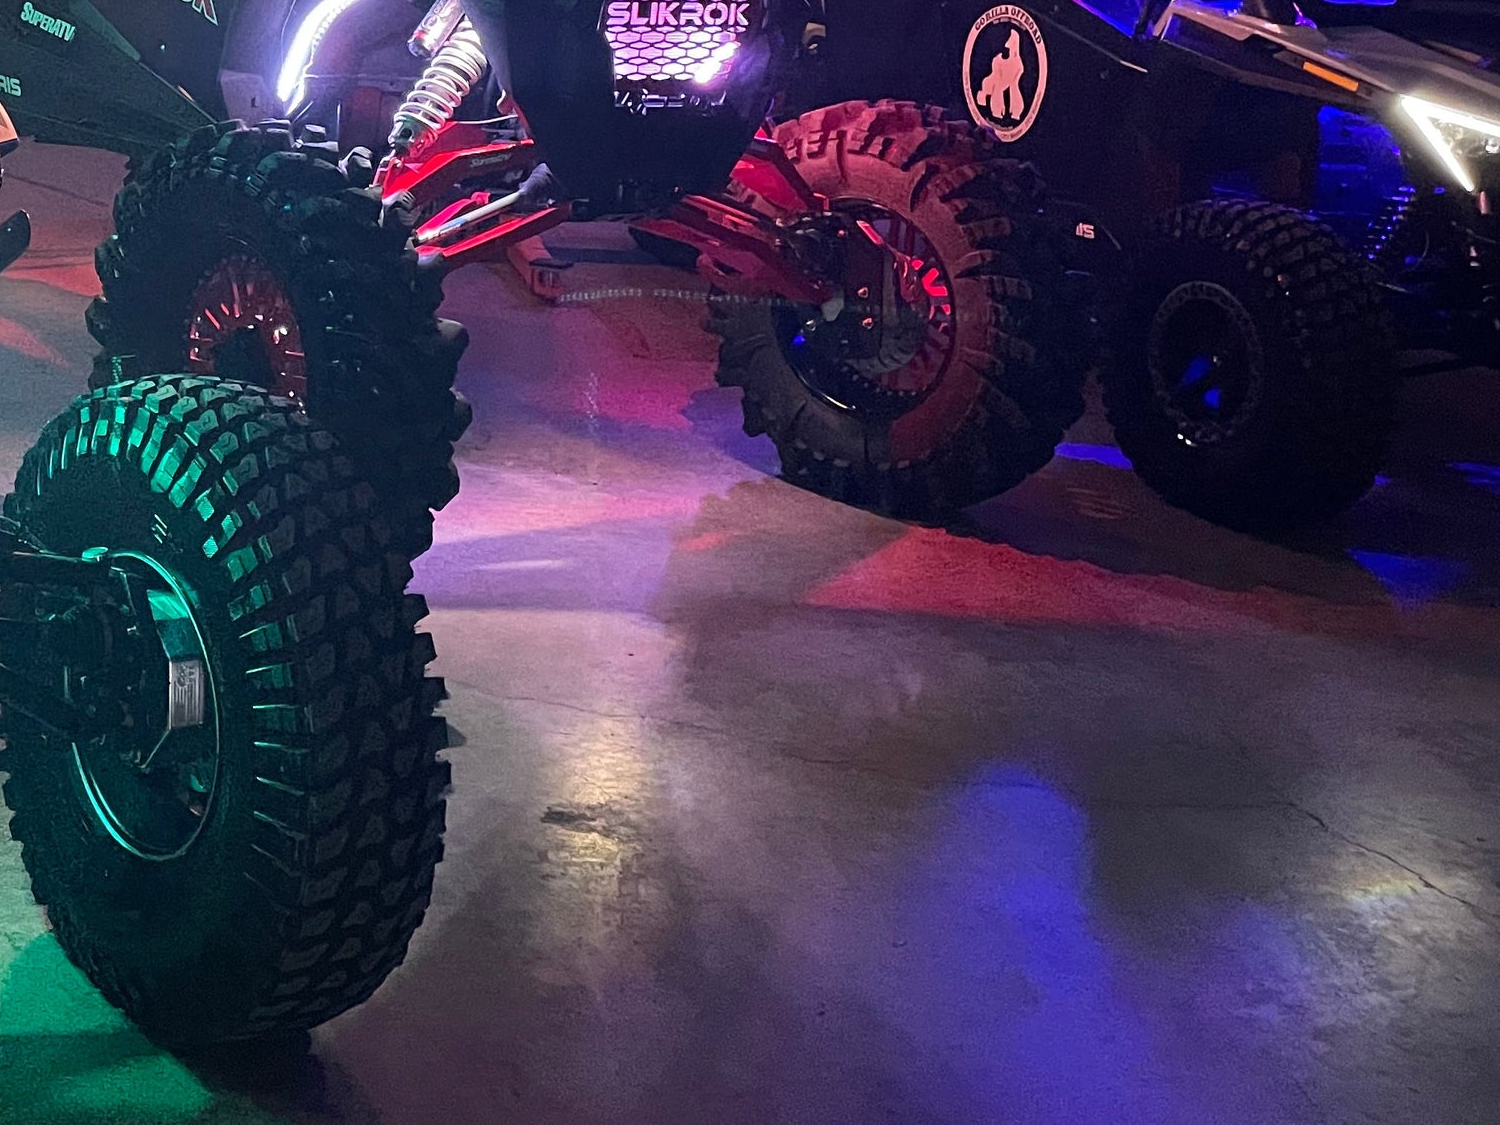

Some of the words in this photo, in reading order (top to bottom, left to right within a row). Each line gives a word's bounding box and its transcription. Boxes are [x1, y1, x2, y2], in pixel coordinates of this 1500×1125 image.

[606, 1, 750, 26] SLIKROK
[975, 6, 1009, 31] GORILLA
[1011, 7, 1042, 44] OFFROAD
